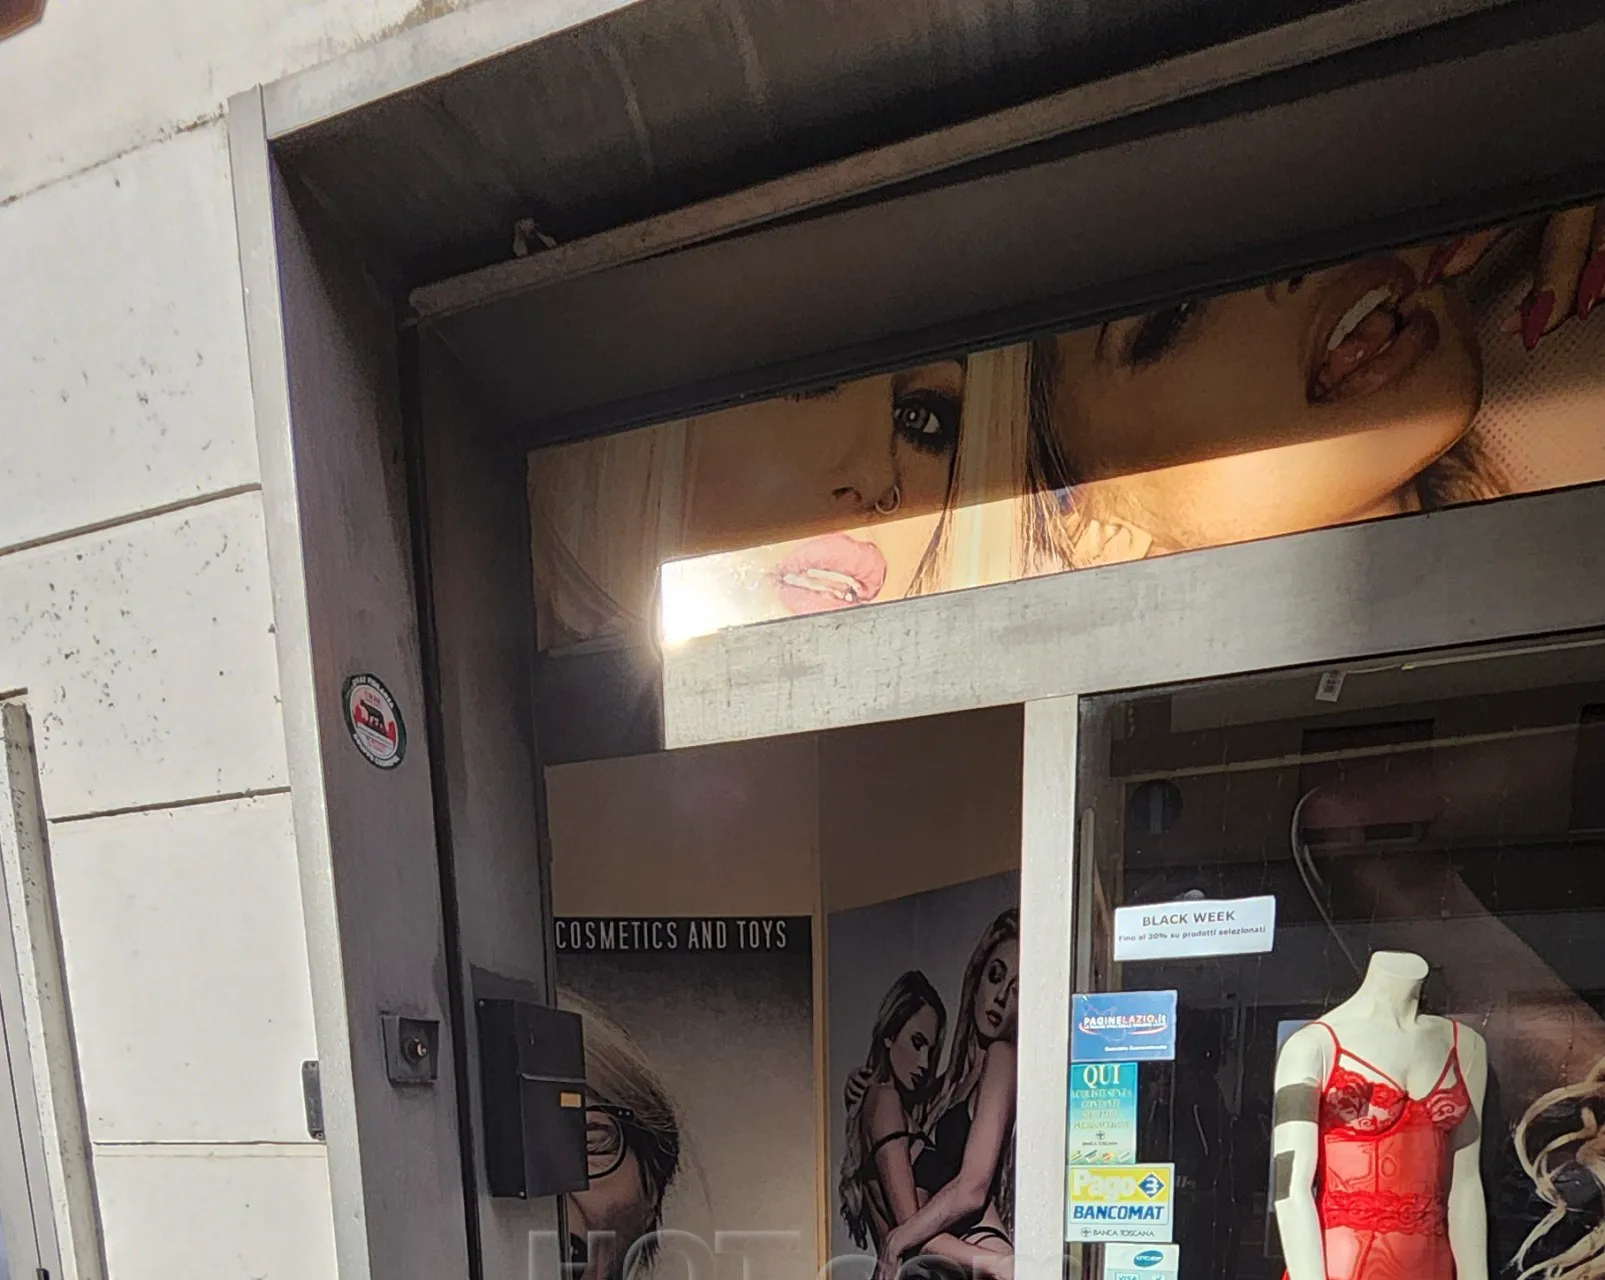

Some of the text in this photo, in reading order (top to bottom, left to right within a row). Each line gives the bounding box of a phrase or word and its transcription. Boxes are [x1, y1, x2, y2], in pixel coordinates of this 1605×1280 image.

[1142, 910, 1236, 927] BLACK WEEK
[554, 920, 787, 950] COSMETICS AND TOYS
[1118, 934, 1136, 942] Fino
[1182, 928, 1217, 940] prodotti
[1218, 926, 1267, 936] selezionati
[1083, 1064, 1121, 1089] QUI
[1072, 1168, 1136, 1200] Pago
[1073, 1205, 1165, 1220] BANCOMAT
[1093, 1228, 1155, 1238] BANCA TOSCANA
